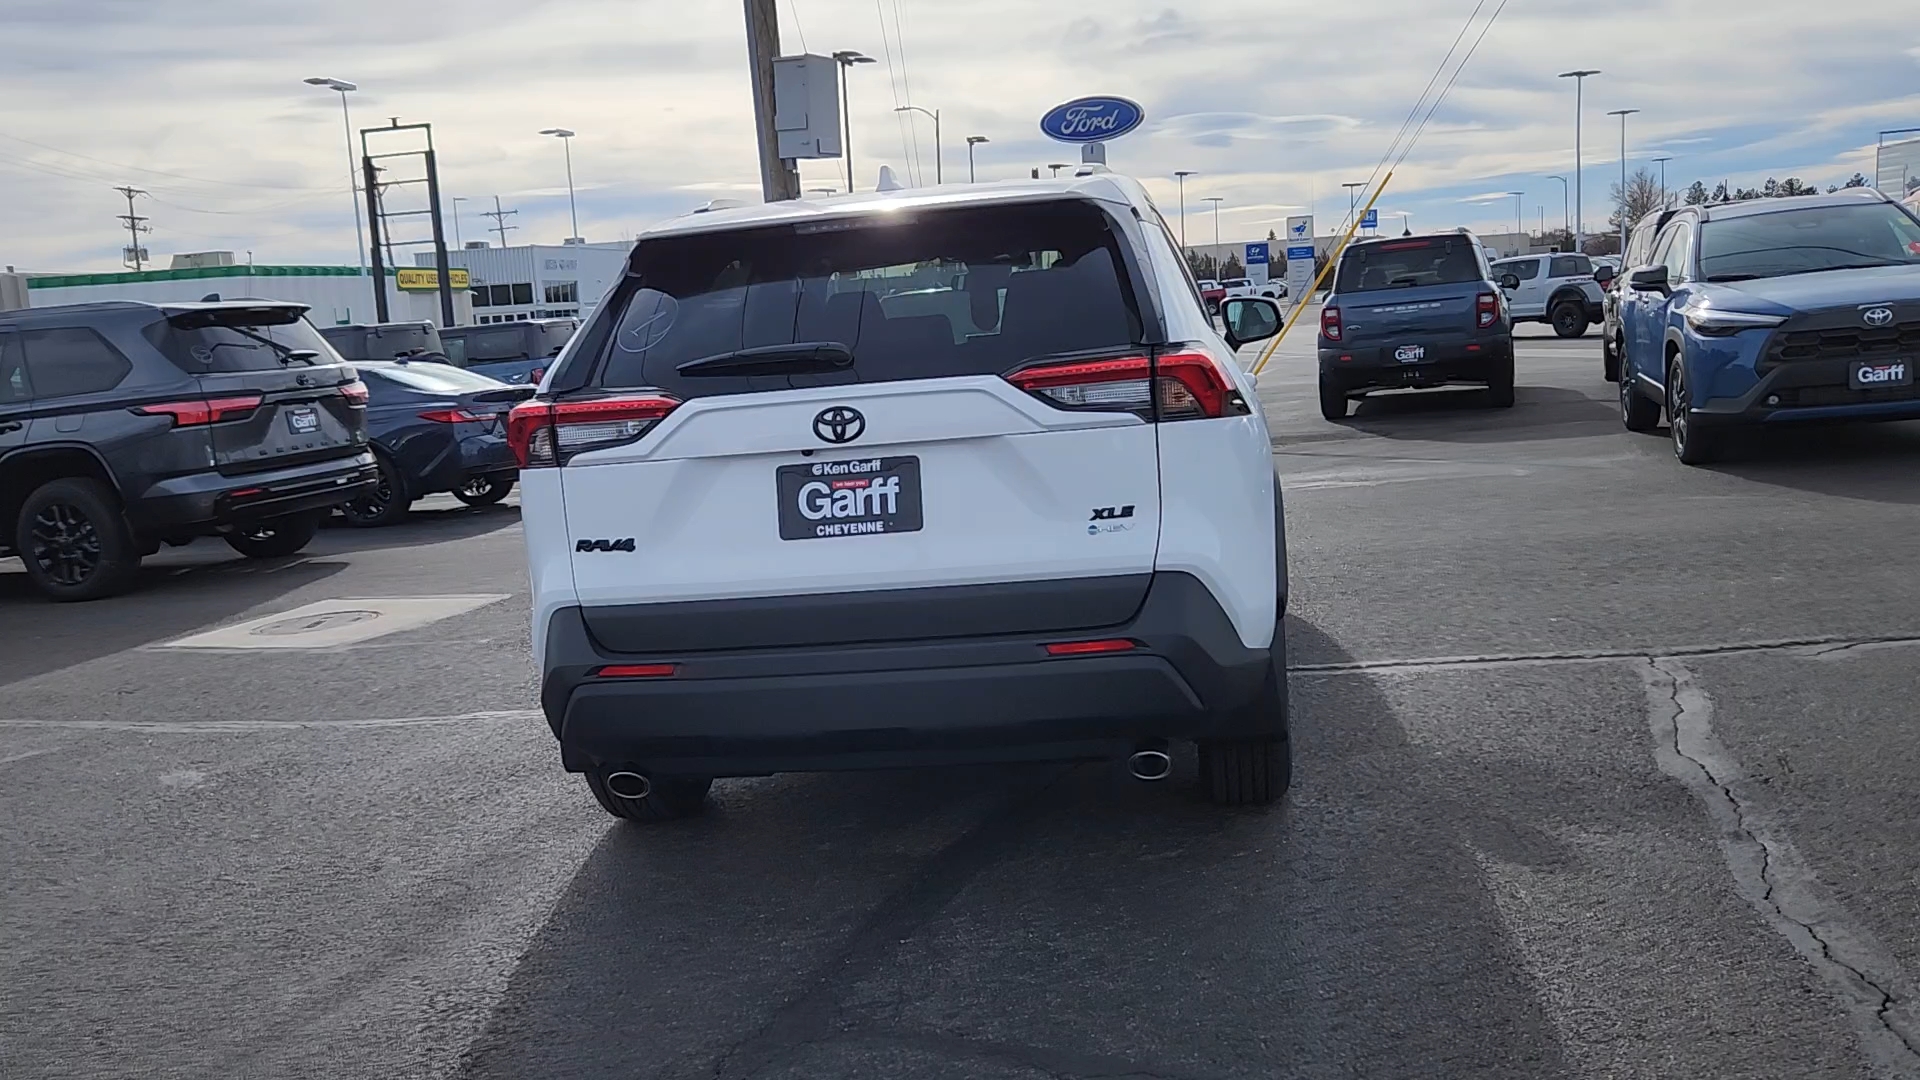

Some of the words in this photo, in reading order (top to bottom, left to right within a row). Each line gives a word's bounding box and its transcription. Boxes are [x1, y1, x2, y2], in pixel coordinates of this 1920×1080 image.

[1060, 104, 1120, 135] Ford
[400, 273, 424, 285] QUALITY
[426, 273, 439, 285] USE
[1394, 346, 1425, 361] Garff
[1857, 364, 1905, 383] Garff
[823, 463, 849, 475] Ken
[849, 460, 882, 473] Garff
[797, 476, 900, 520] Garff
[1088, 505, 1136, 521] XLE
[816, 521, 885, 536] CHEYENNE
[575, 537, 637, 553] RAV4
